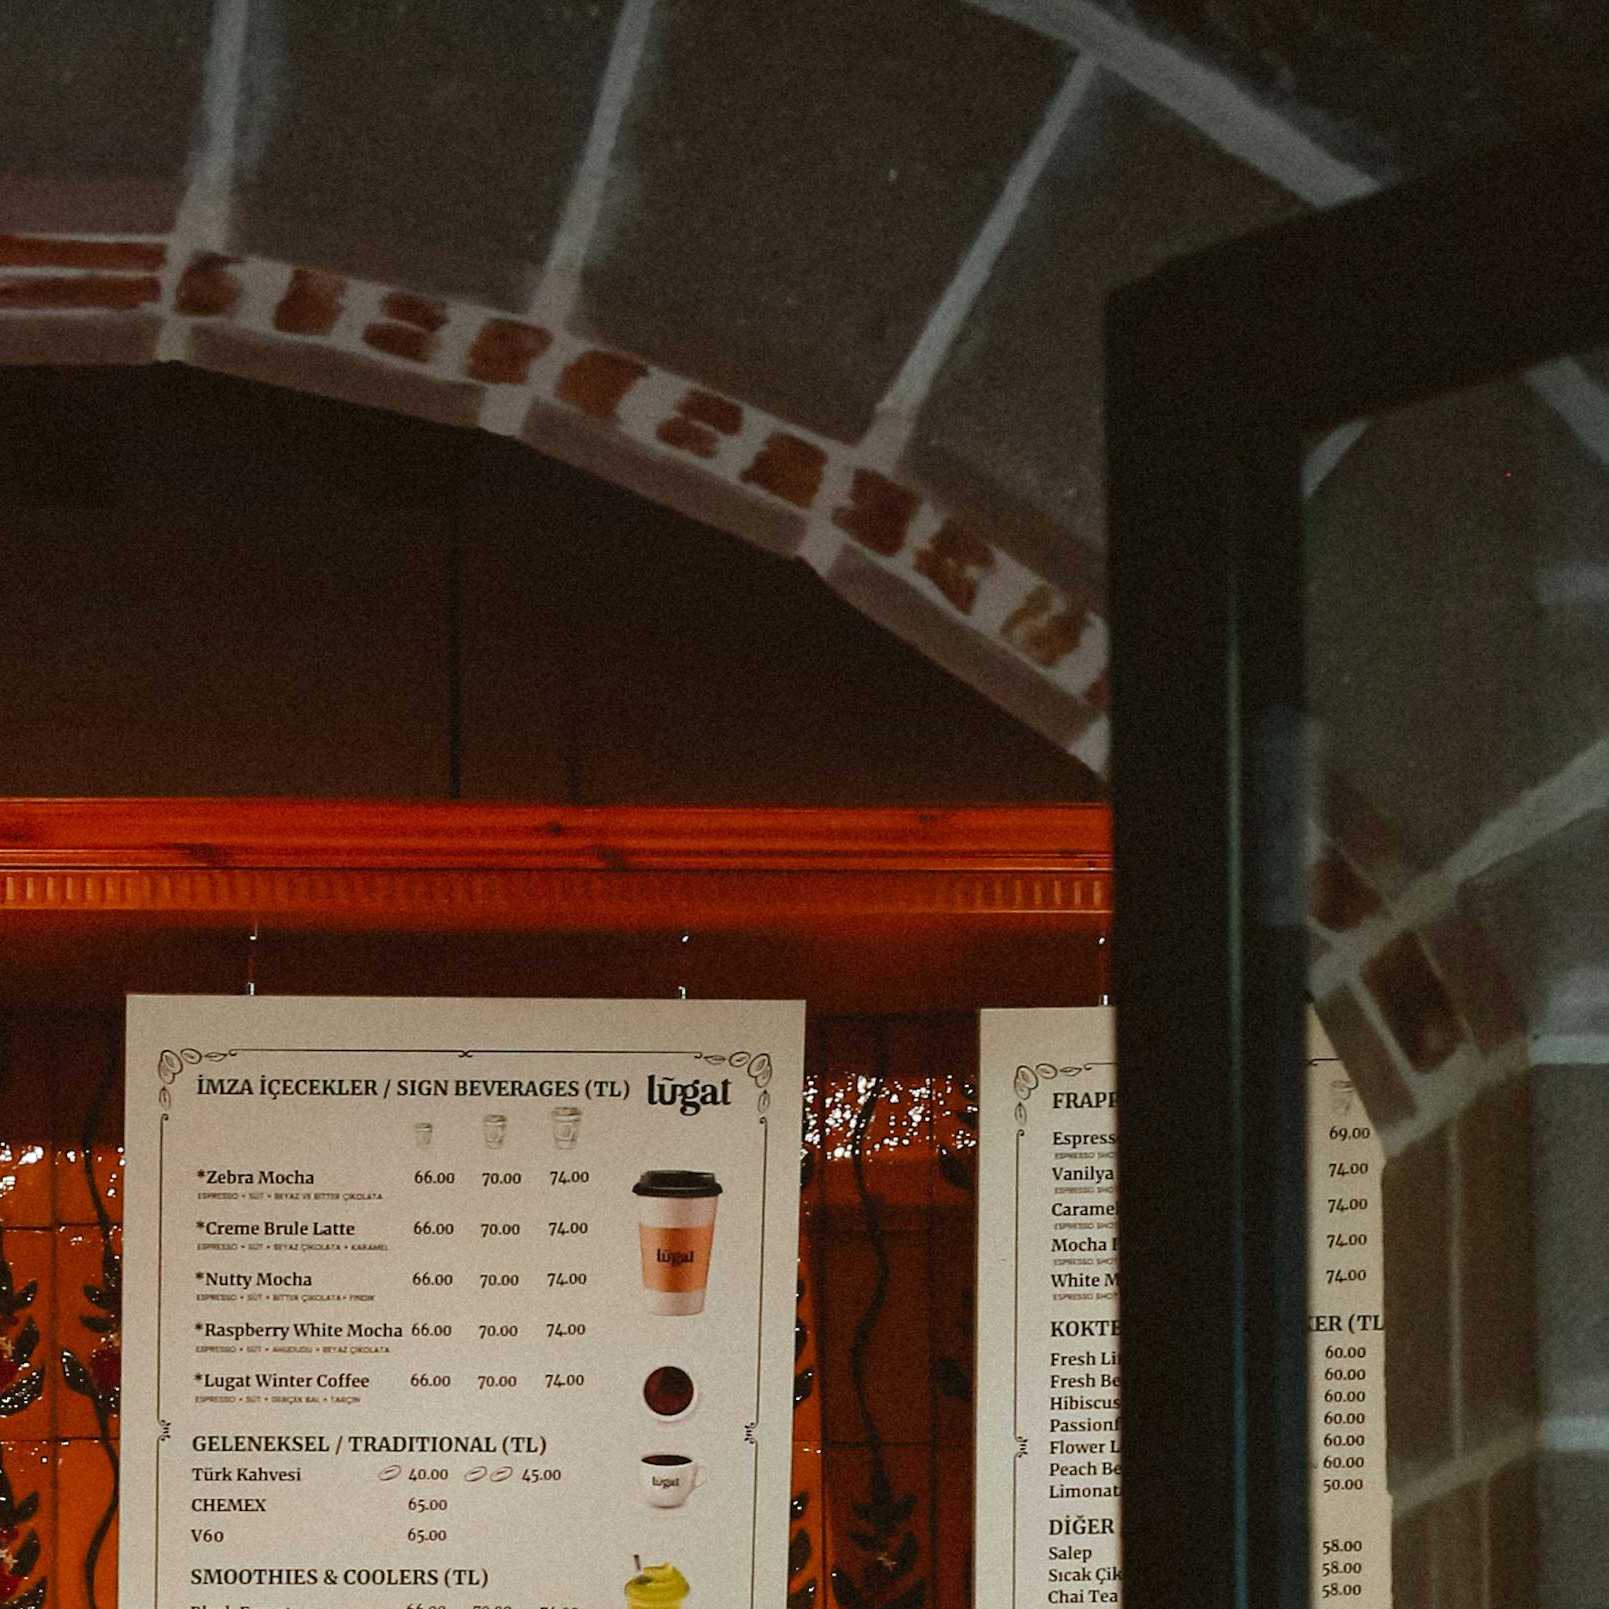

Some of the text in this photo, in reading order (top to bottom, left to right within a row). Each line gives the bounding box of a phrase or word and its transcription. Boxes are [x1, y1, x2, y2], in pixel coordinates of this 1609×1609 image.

[197, 1074, 254, 1095] İMZA
[259, 1075, 378, 1100] İÇECEKLER
[397, 1080, 449, 1096] SIGN
[454, 1080, 579, 1097] BEVERAGES
[585, 1079, 630, 1100] (TL)
[1329, 1126, 1370, 1141] 69.00
[258, 1170, 314, 1184] Mocha
[414, 1170, 455, 1184] 66.00
[482, 1173, 521, 1187] 70.00
[550, 1171, 589, 1185] 74.00
[1052, 1166, 1114, 1184] Vanilya
[264, 1221, 308, 1235] Brule
[313, 1222, 355, 1236] Latte
[1051, 1238, 1106, 1252] Mocha
[256, 1272, 312, 1286] Mocha
[1051, 1273, 1099, 1287] White
[293, 1322, 343, 1337] White
[347, 1323, 403, 1337] Mocha
[1050, 1351, 1095, 1366] Fresh
[1325, 1345, 1366, 1359] 60.00
[255, 1373, 313, 1388] Winter
[316, 1373, 370, 1388] Coffee
[1050, 1373, 1095, 1388] Fresh
[192, 1436, 330, 1452] GELENEKSEL
[348, 1436, 497, 1453] TRADITIONAL
[502, 1436, 547, 1456] (TL)
[1050, 1440, 1105, 1454] Flower
[191, 1467, 561, 1483] Türk Kahvesi 40.00 45.00
[1050, 1461, 1097, 1476] Peach
[1323, 1478, 1363, 1492] 50.00
[191, 1497, 447, 1513] CHEMEX 65.00
[1049, 1515, 1114, 1535] DİĞER
[191, 1529, 224, 1542] V60
[1048, 1546, 1092, 1562] Salep
[1323, 1539, 1362, 1555] 58.00
[191, 1569, 318, 1585] SMOOTHIES
[343, 1569, 438, 1585] COOLERS
[444, 1568, 488, 1589] (TL)
[1048, 1567, 1091, 1582] Sıcak
[1048, 1590, 1118, 1604] Chai Tea
